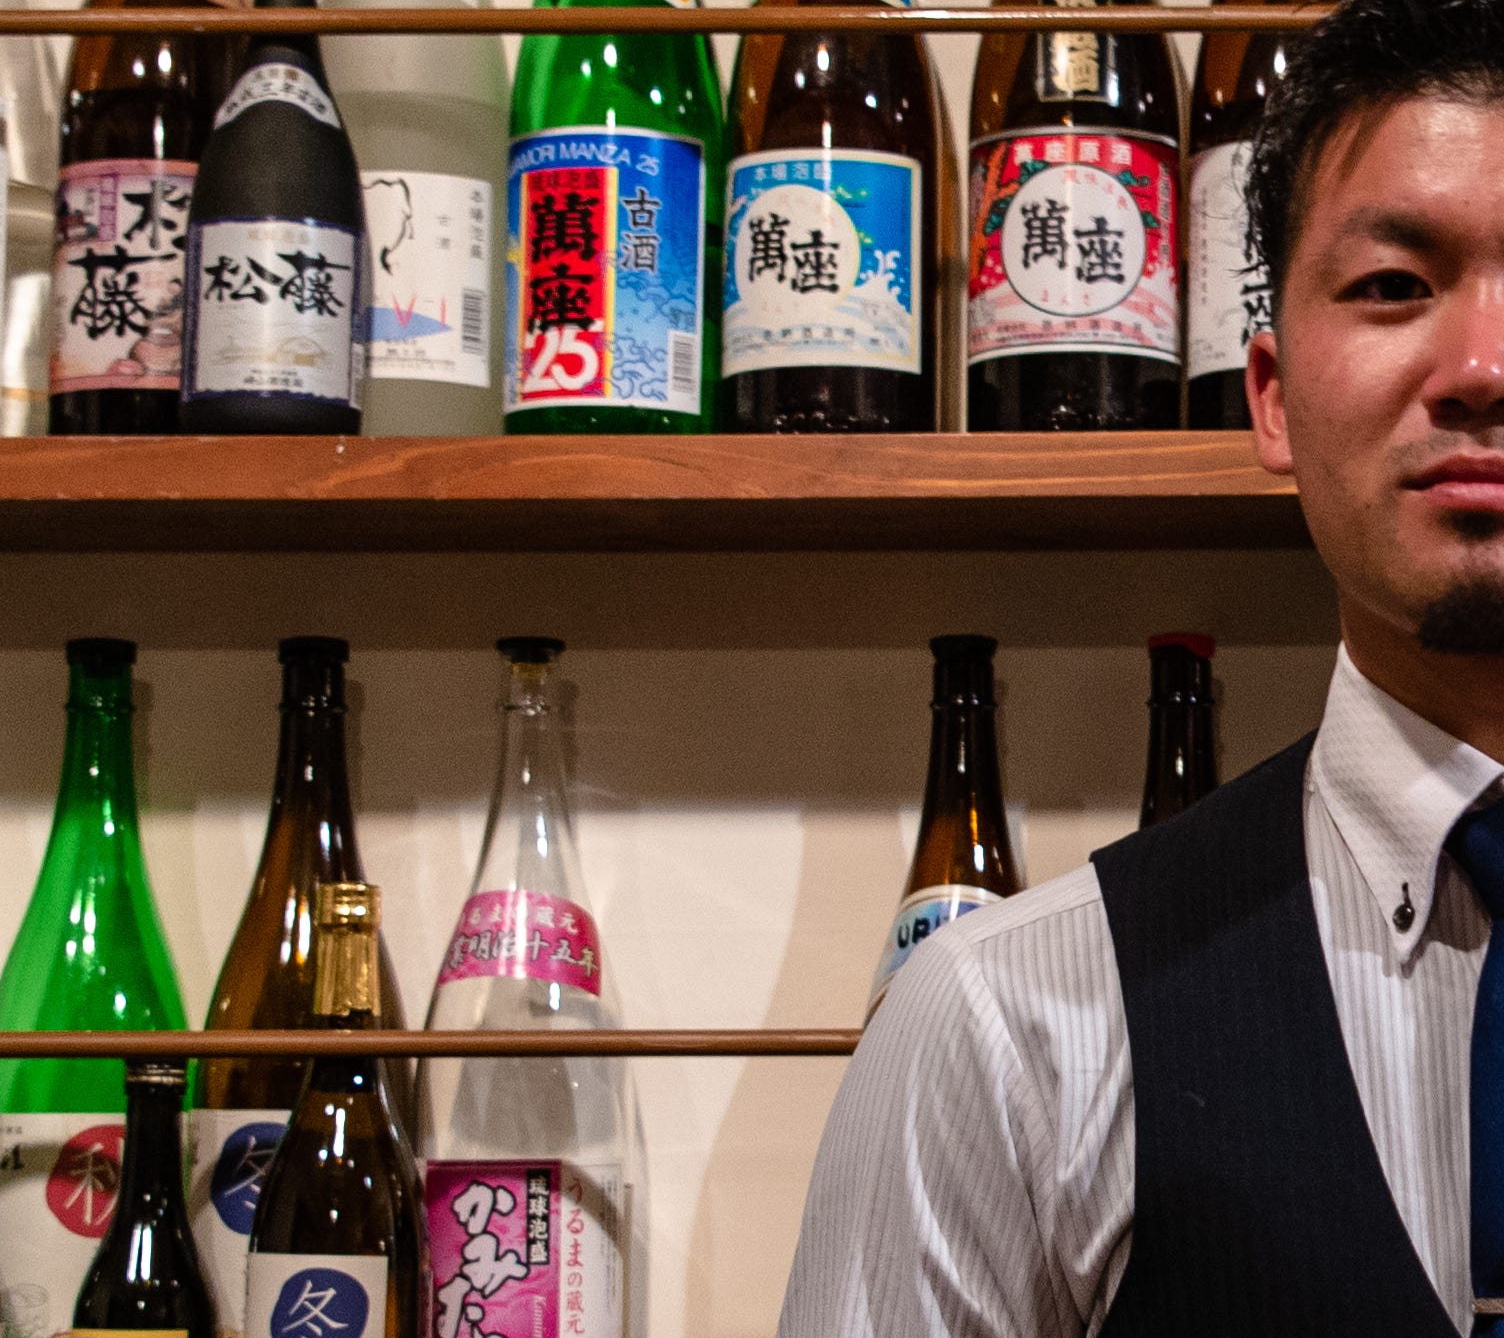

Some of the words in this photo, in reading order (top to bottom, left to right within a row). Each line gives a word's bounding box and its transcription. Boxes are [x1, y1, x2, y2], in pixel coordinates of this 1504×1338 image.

[528, 190, 603, 335] 萬座
[621, 186, 664, 274] 古酒
[747, 212, 842, 296] 萬座
[1019, 195, 1126, 285] 萬座
[202, 252, 353, 321] 松藤
[522, 323, 604, 396] 25
[525, 1167, 551, 1267] 琉球泡盛
